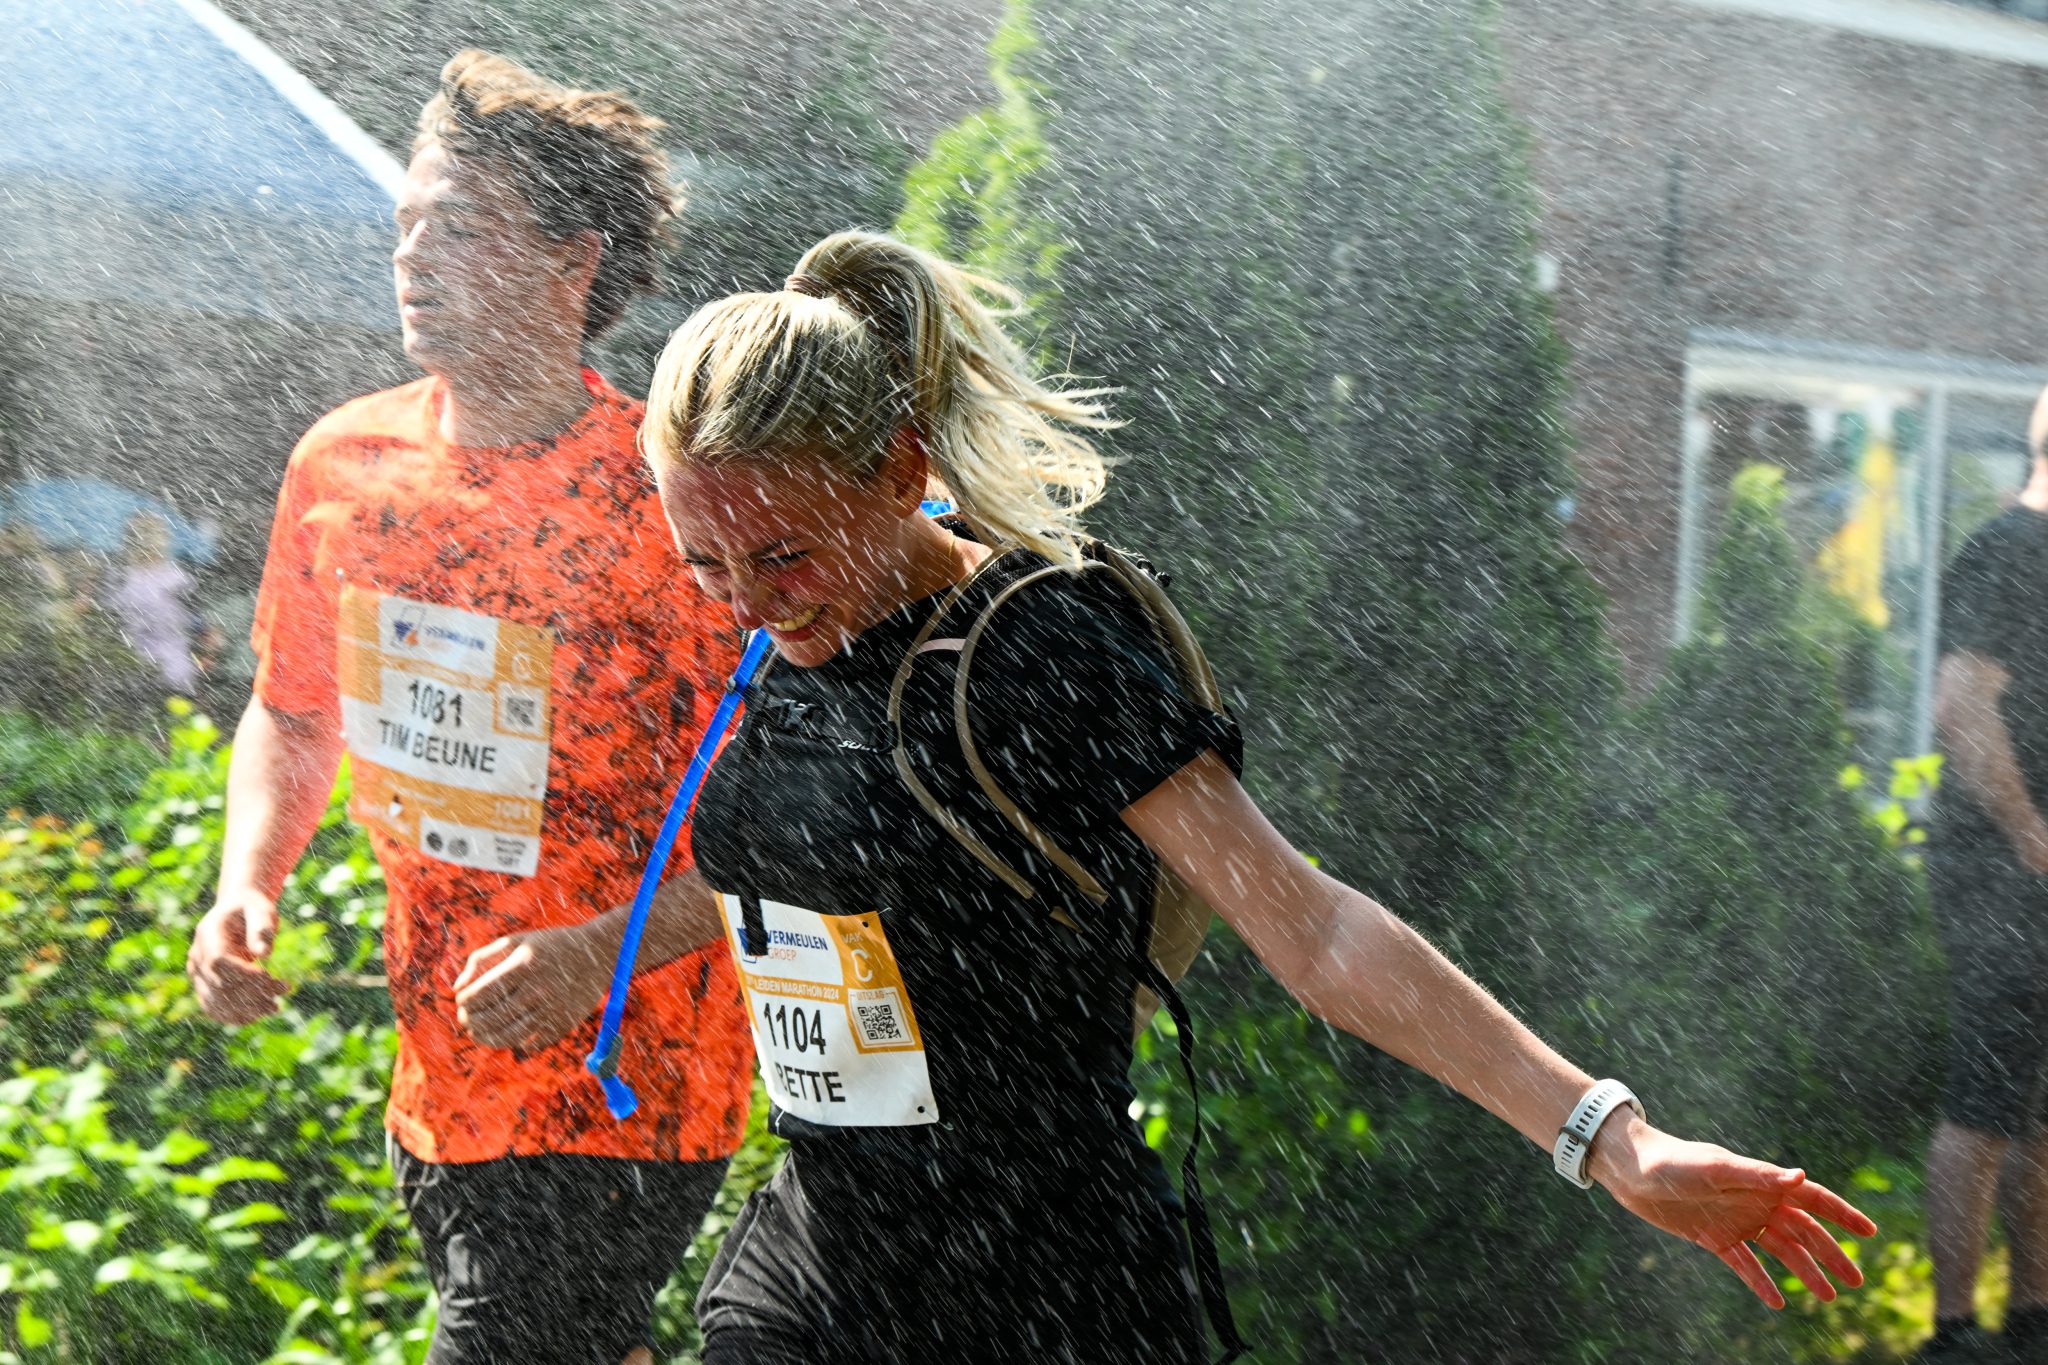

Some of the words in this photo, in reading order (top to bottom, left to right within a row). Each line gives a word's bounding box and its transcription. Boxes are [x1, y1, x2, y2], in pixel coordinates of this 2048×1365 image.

[408, 680, 463, 728] 1081
[378, 718, 410, 752] TIM
[412, 732, 497, 773] BEUNE
[851, 948, 873, 982] C
[781, 981, 822, 998] MARATHON
[764, 1002, 826, 1055] 1104
